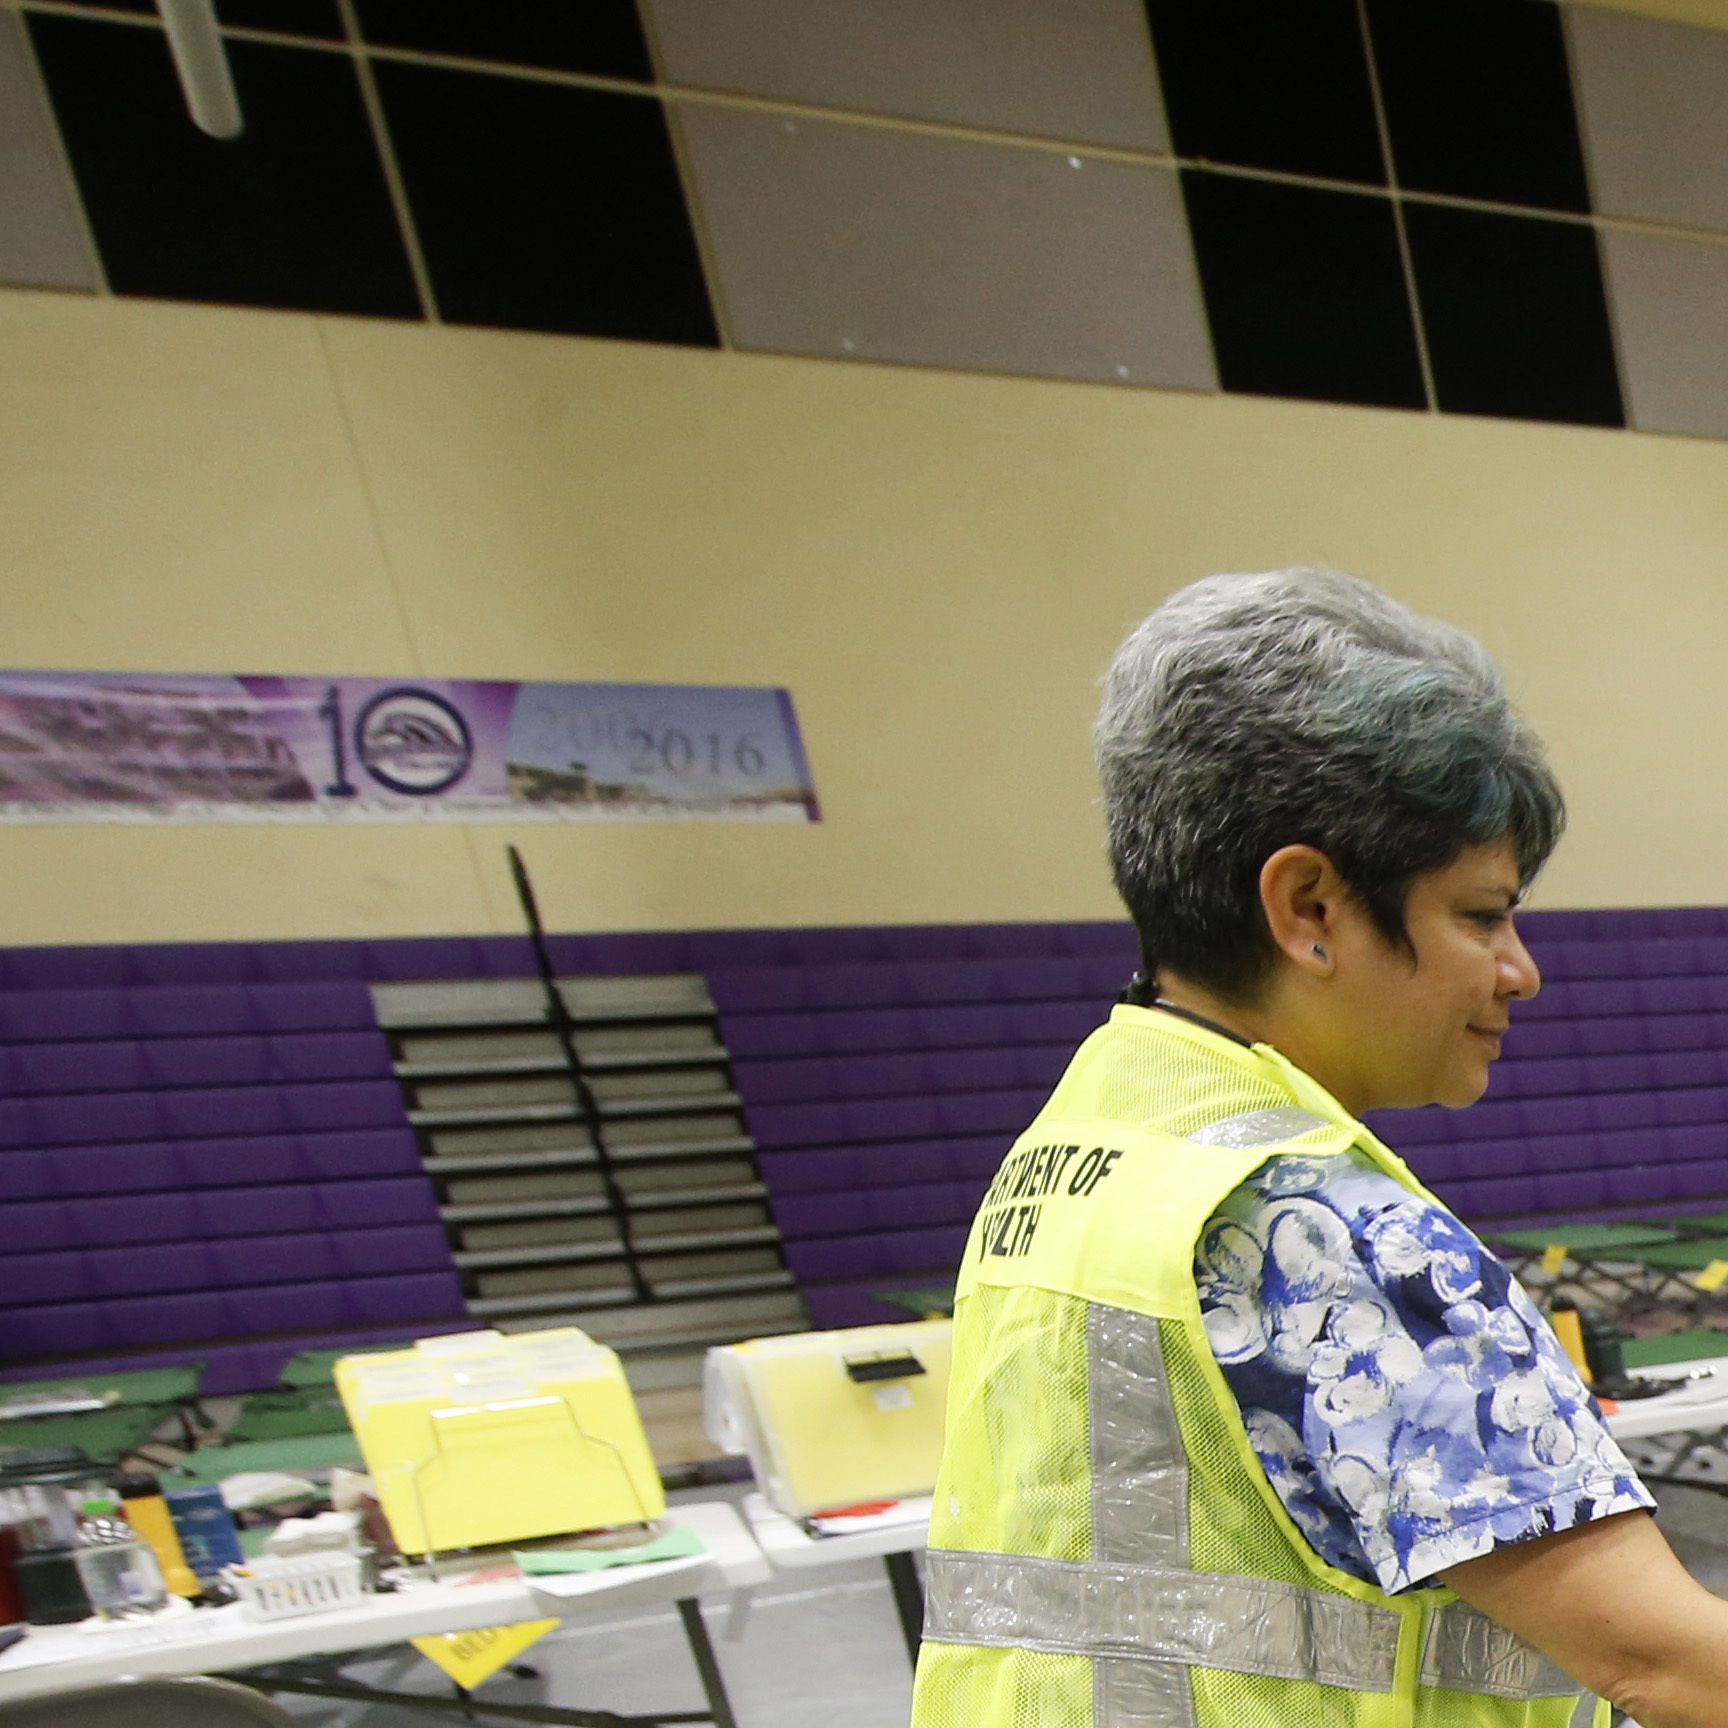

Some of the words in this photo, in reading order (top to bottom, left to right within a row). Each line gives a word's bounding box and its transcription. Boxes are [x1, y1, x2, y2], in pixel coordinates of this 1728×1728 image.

[628, 726, 766, 776] 2016
[984, 1144, 1081, 1209] ARTMENT
[1067, 1147, 1125, 1198] OF
[449, 1627, 499, 1663] BED
